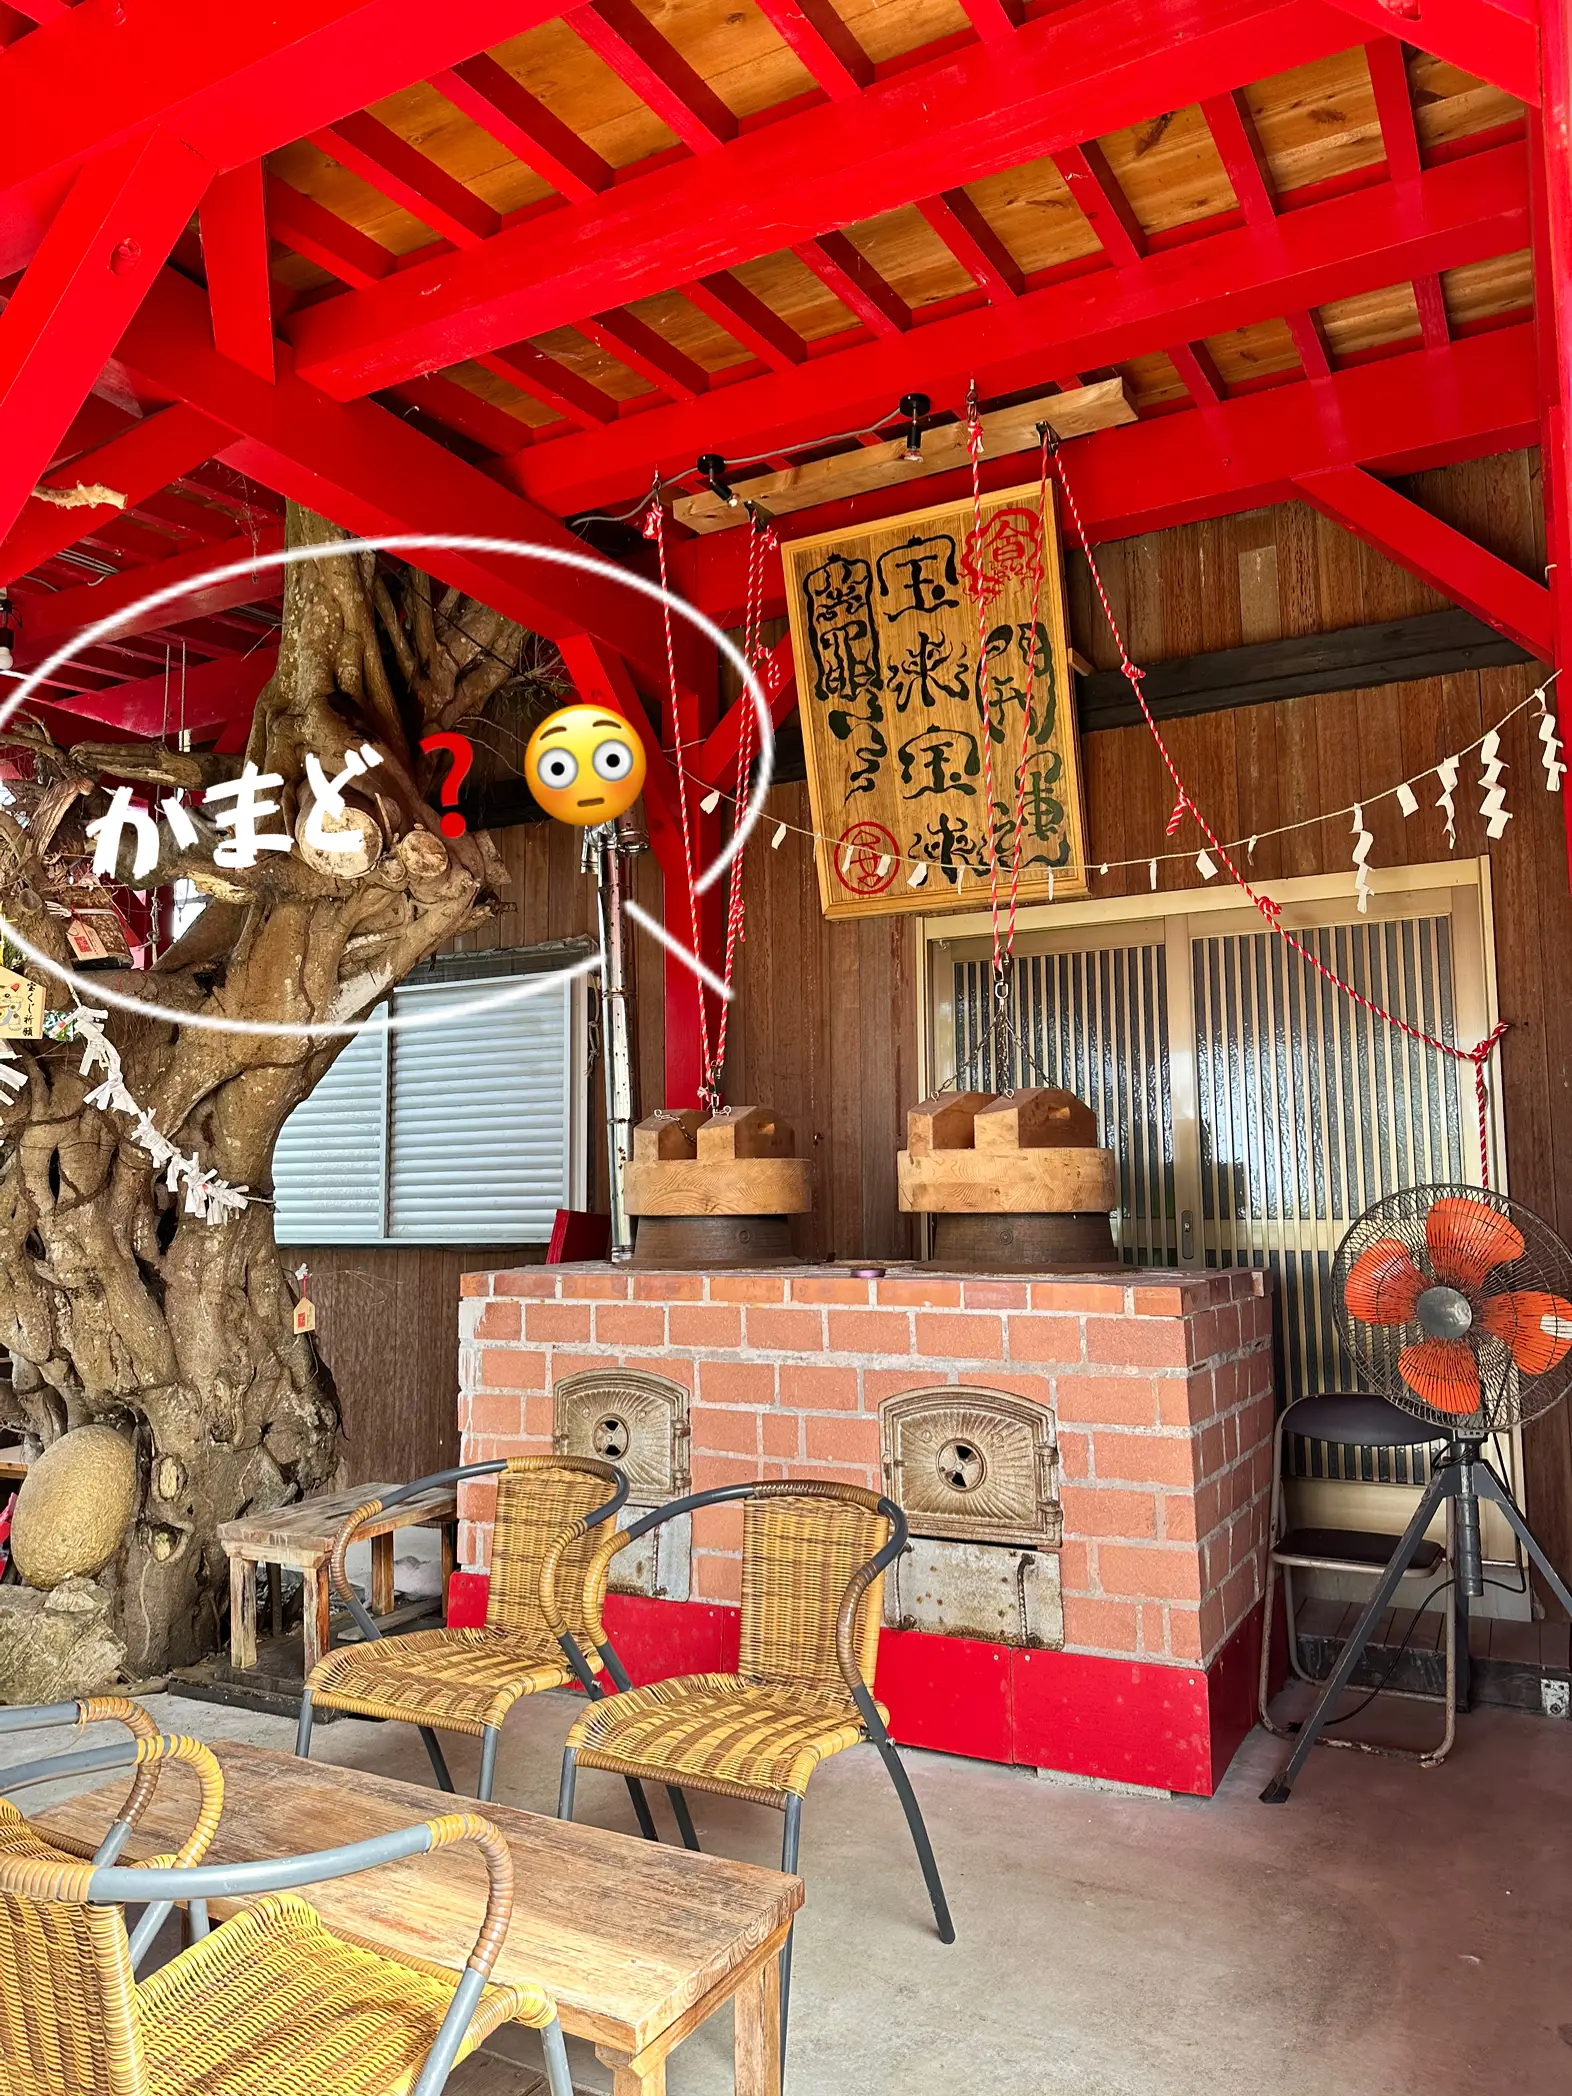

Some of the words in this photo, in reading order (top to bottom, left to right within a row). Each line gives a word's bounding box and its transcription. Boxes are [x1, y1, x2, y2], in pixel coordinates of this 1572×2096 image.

[975, 622, 1071, 873] 開運
[22, 981, 37, 1037] 宝くじ祈願
